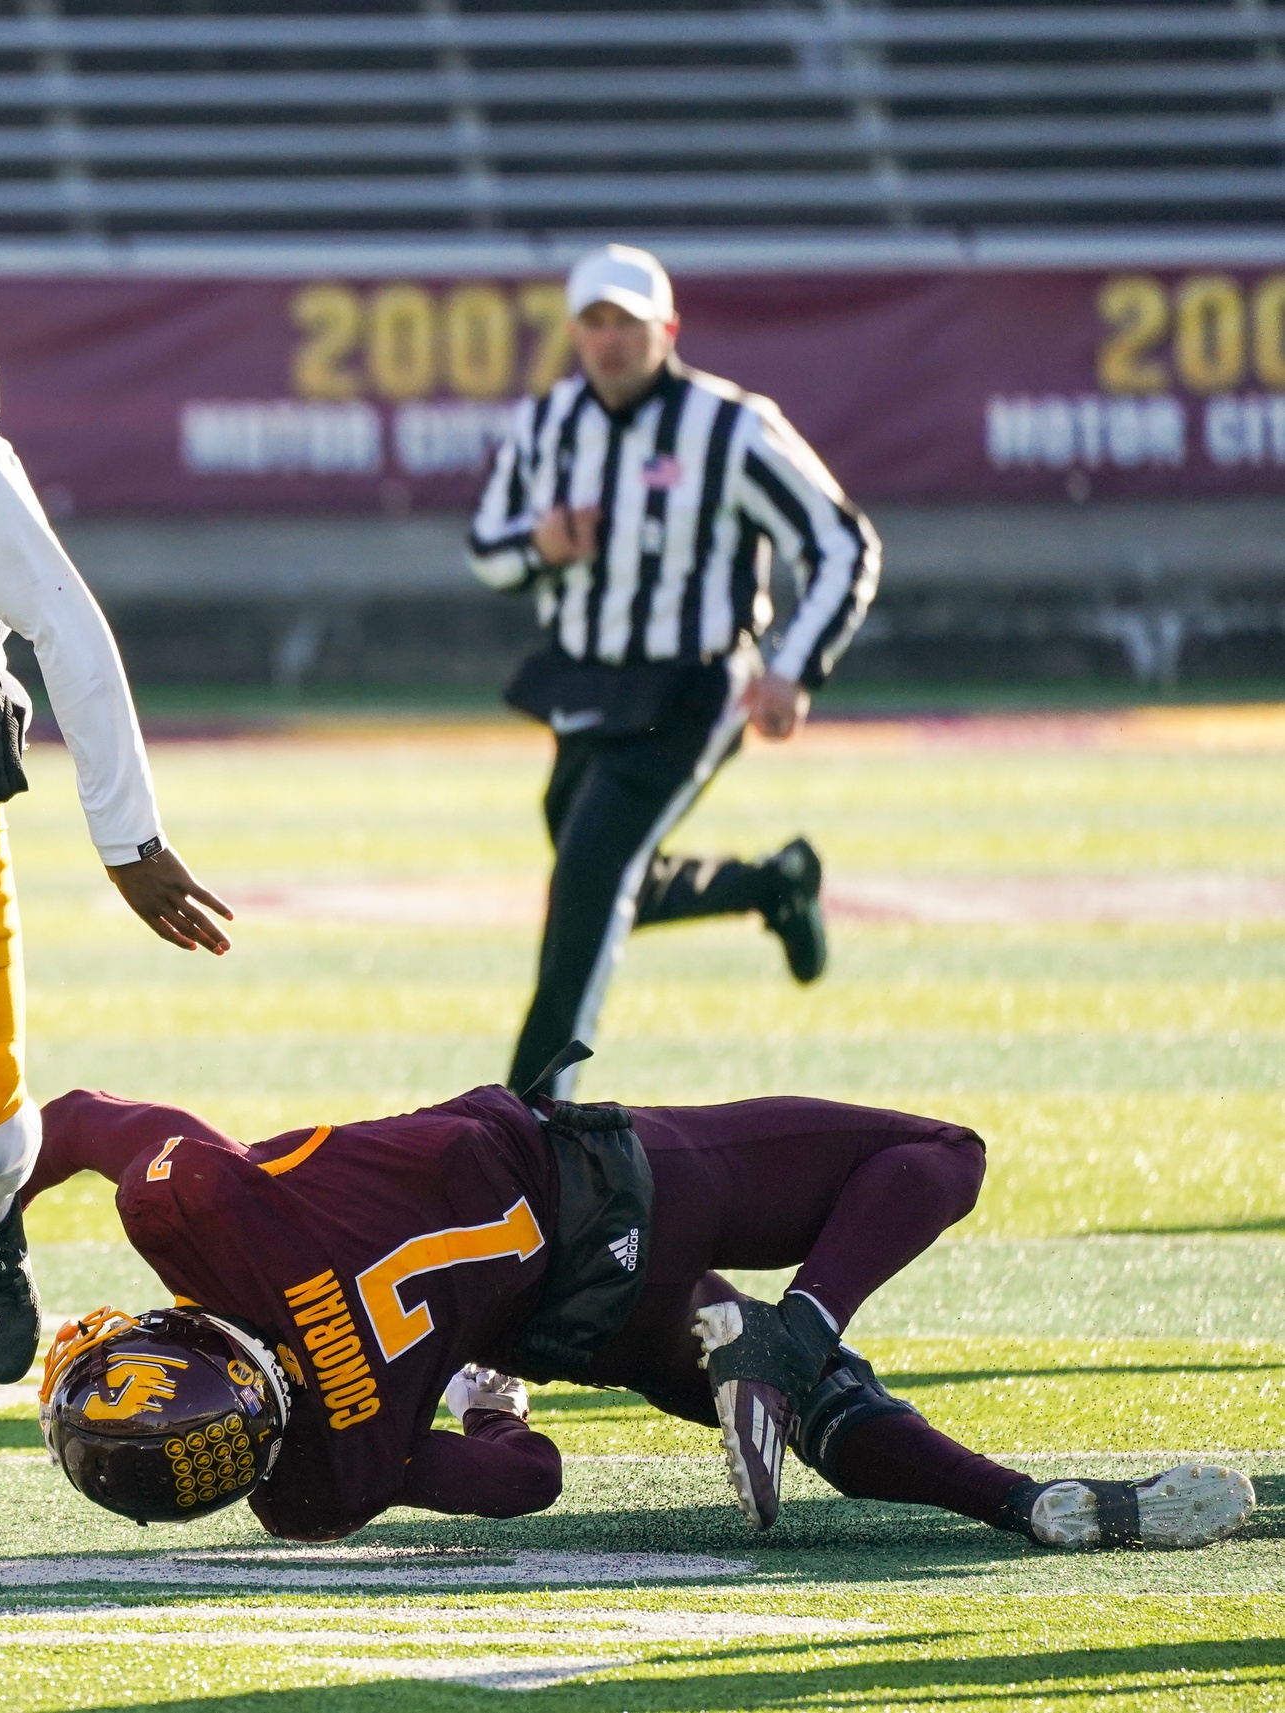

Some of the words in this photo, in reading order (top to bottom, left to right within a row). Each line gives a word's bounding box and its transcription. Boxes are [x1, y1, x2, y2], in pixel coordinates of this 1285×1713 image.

[295, 284, 569, 396] 2007
[146, 1135, 184, 1182] 7
[354, 1195, 545, 1364] 7
[627, 1228, 639, 1272] adidas
[284, 1268, 381, 1431] CONORAN
